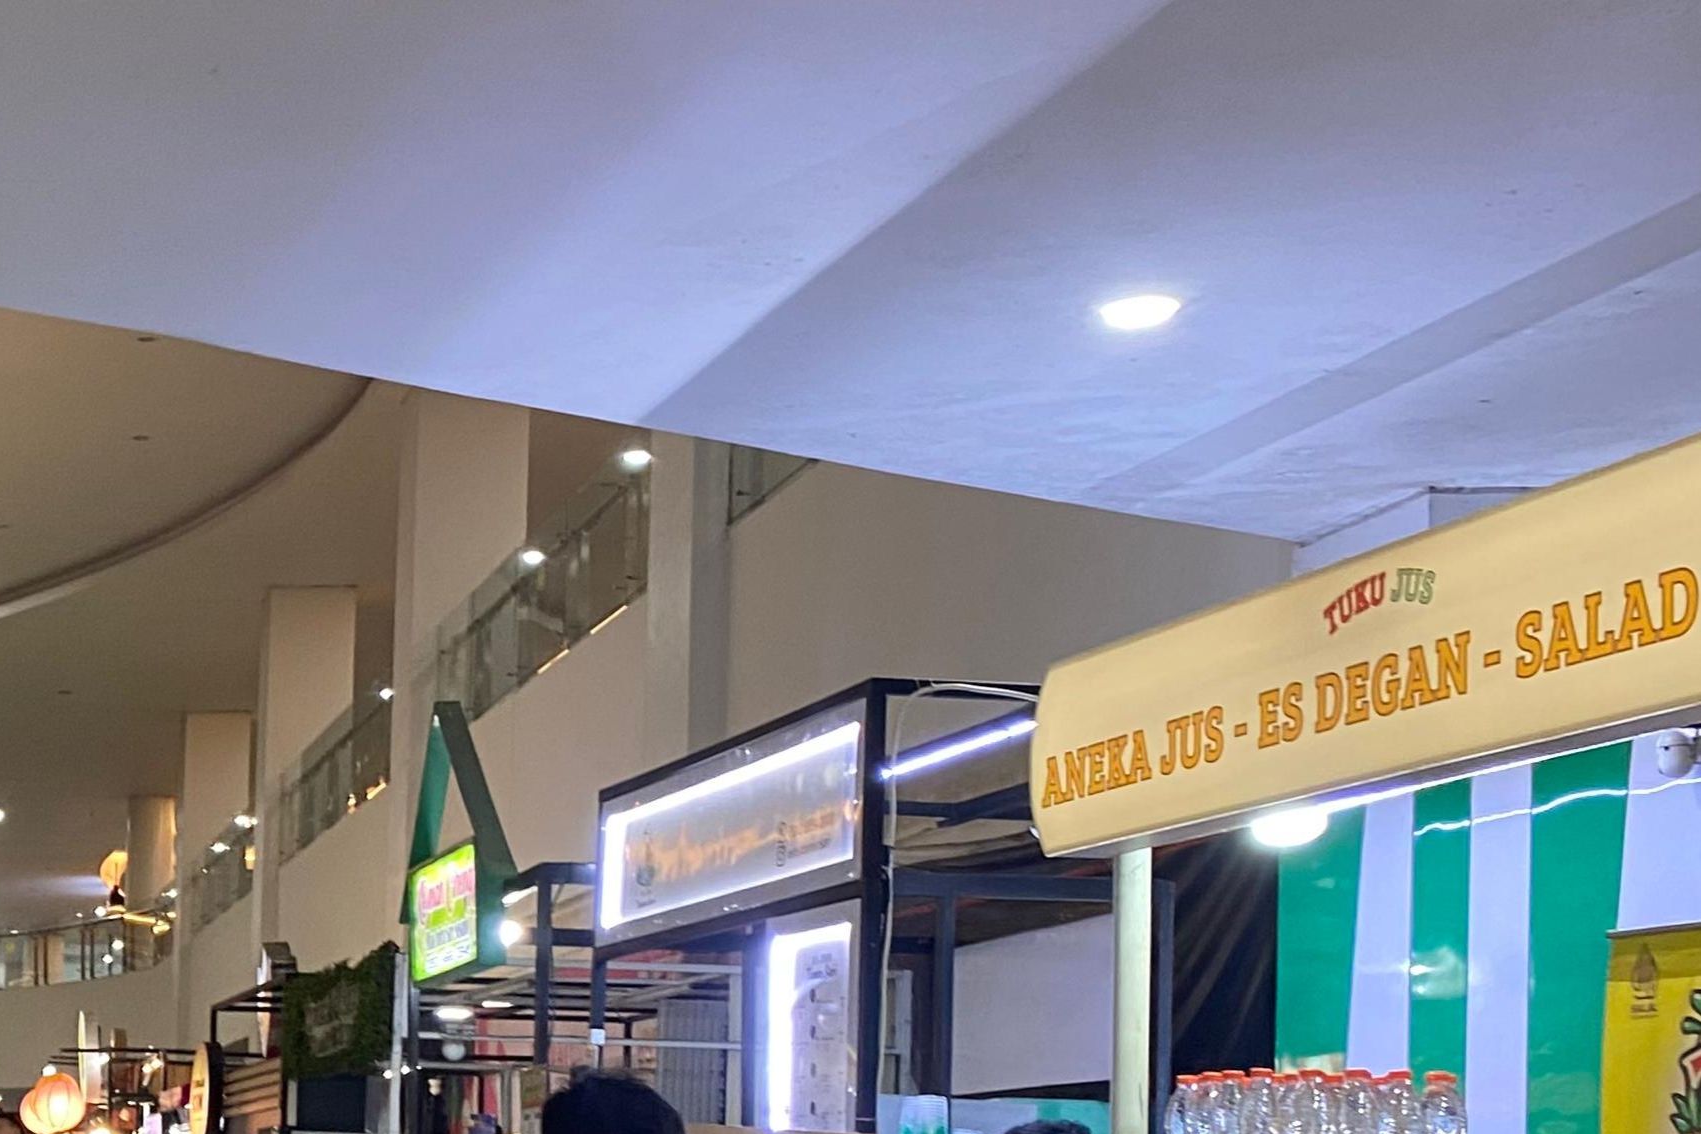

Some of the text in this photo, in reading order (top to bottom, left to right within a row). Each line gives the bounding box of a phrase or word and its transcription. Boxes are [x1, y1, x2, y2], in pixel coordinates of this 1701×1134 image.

[1323, 567, 1436, 635] TUKU JUS
[1041, 729, 1152, 809] ANEKA
[1160, 705, 1224, 776] JUS
[1258, 681, 1304, 750] ES
[1314, 630, 1471, 733] DEGAN
[1515, 566, 1699, 679] SALAD
